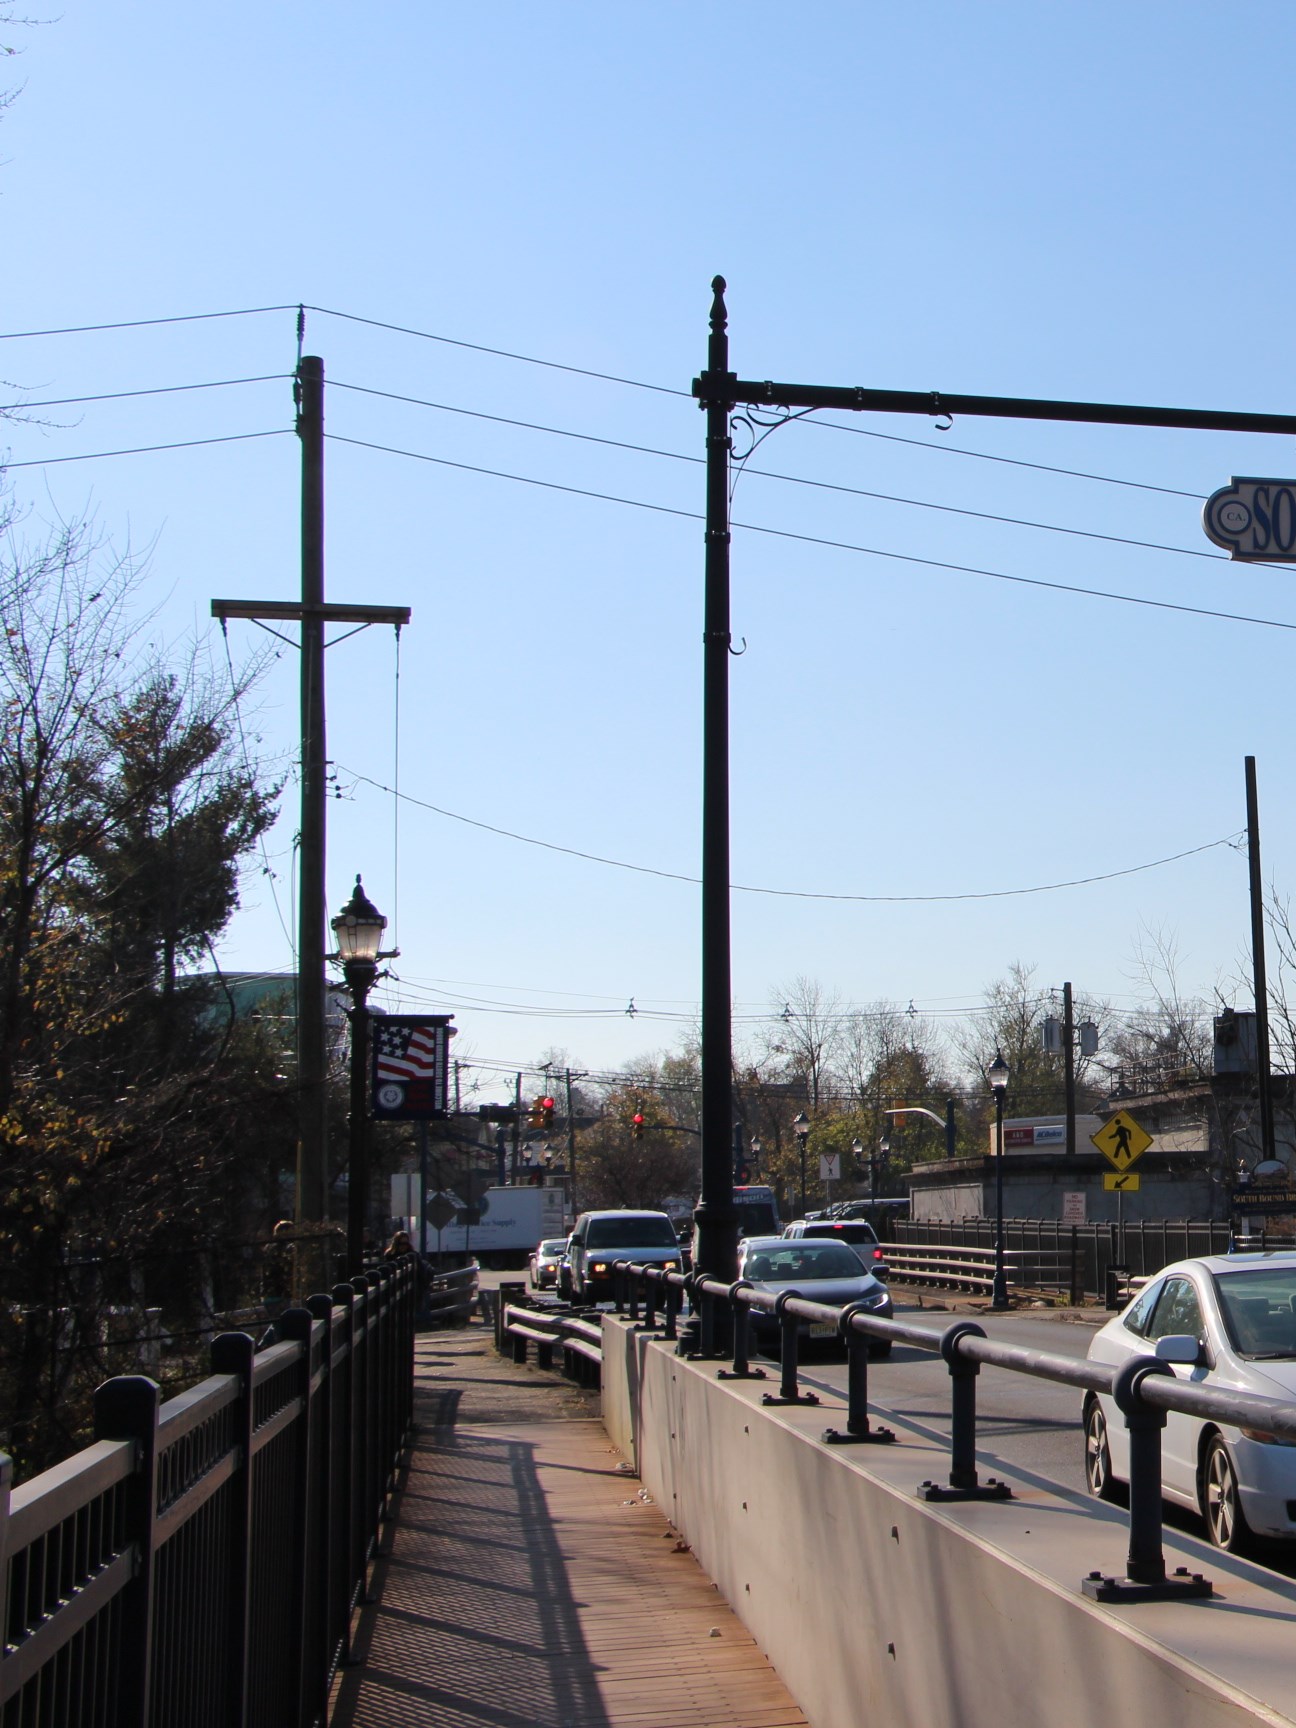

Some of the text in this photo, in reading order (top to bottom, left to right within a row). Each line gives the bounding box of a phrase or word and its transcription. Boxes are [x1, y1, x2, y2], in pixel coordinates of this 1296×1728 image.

[1226, 511, 1246, 522] CA.
[1233, 1194, 1258, 1204] SOUTH
[1259, 1193, 1285, 1203] BOUND
